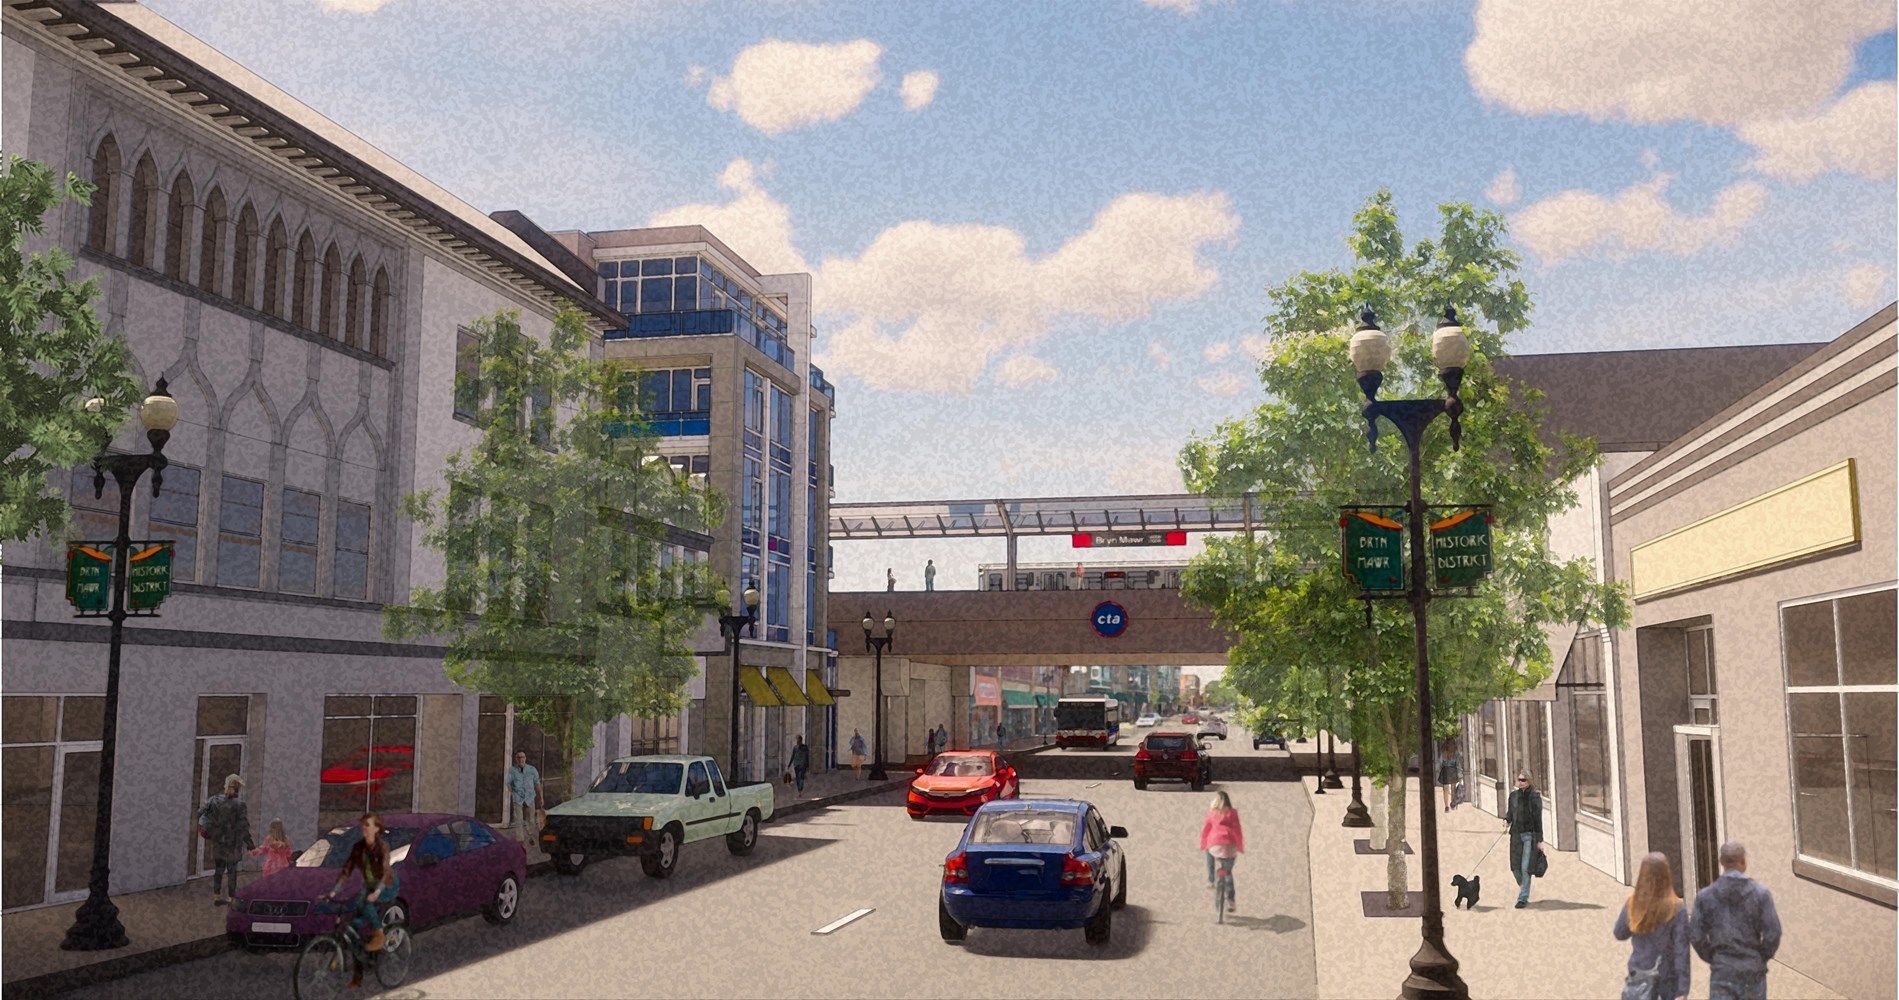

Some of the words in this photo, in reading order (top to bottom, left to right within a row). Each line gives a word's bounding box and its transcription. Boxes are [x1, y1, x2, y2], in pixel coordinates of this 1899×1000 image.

[1095, 536, 1117, 545] Bryn
[1118, 535, 1144, 544] Mawr
[1359, 536, 1388, 549] BRYN
[1435, 534, 1488, 549] HISTORIC
[1357, 556, 1390, 569] MAWR
[1437, 553, 1489, 569] DISTRICT
[80, 566, 100, 577] BRYN
[132, 565, 169, 577] HISTORIC
[76, 582, 100, 593] MAWR
[132, 581, 168, 593] DISTRICT
[1097, 613, 1121, 625] cta
